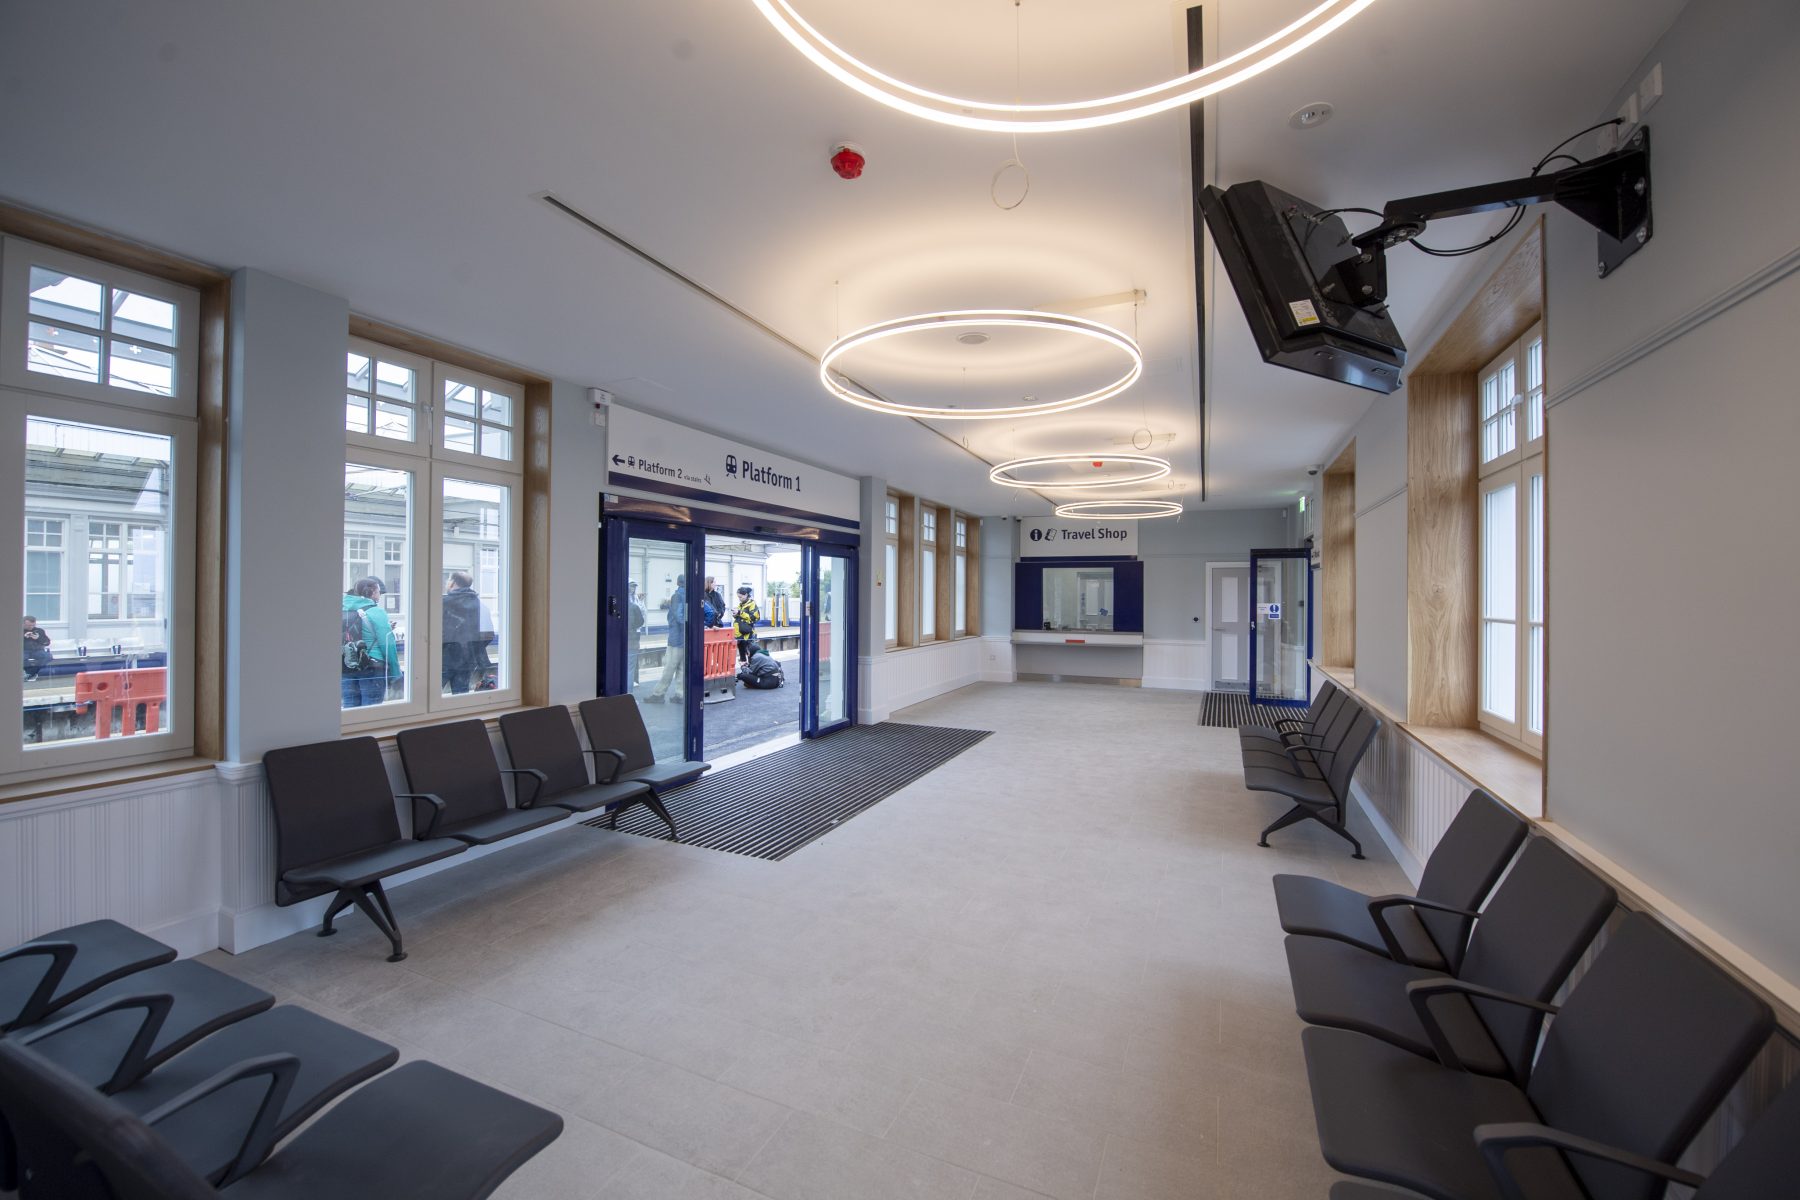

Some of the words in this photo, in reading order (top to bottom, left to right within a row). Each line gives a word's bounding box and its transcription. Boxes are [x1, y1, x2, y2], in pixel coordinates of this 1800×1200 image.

[638, 459, 676, 477] Platform
[677, 468, 683, 479] 2
[742, 460, 792, 490] Platform
[795, 475, 801, 492] 1
[1061, 528, 1095, 540] Travel
[1098, 528, 1127, 541] Shop
